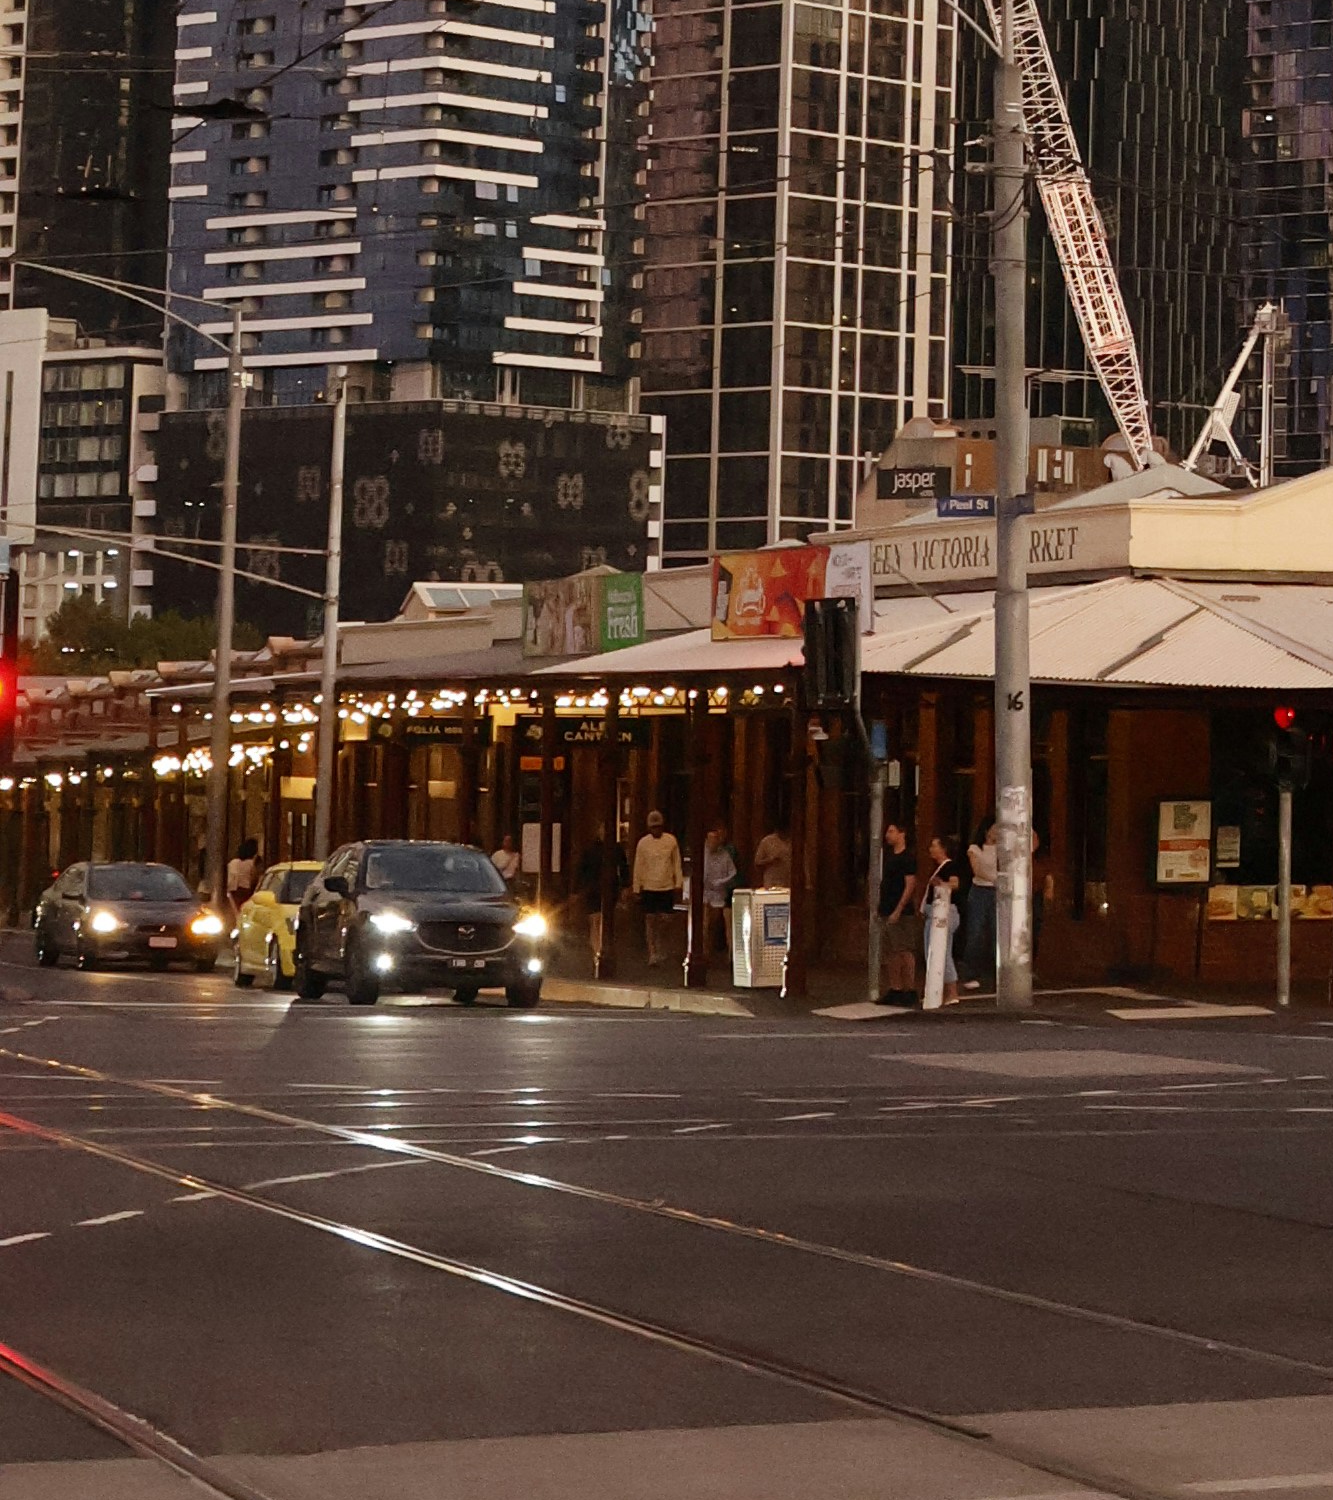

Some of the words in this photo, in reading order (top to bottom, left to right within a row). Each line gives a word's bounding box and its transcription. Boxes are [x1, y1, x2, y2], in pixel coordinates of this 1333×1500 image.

[892, 471, 935, 495] jasper
[949, 499, 973, 510] Peel
[976, 499, 989, 510] St
[873, 543, 901, 574] EEN
[912, 535, 990, 571] VICTORIA
[1029, 527, 1079, 563] RKET
[1007, 691, 1023, 711] 16
[563, 731, 632, 742] CANTN
